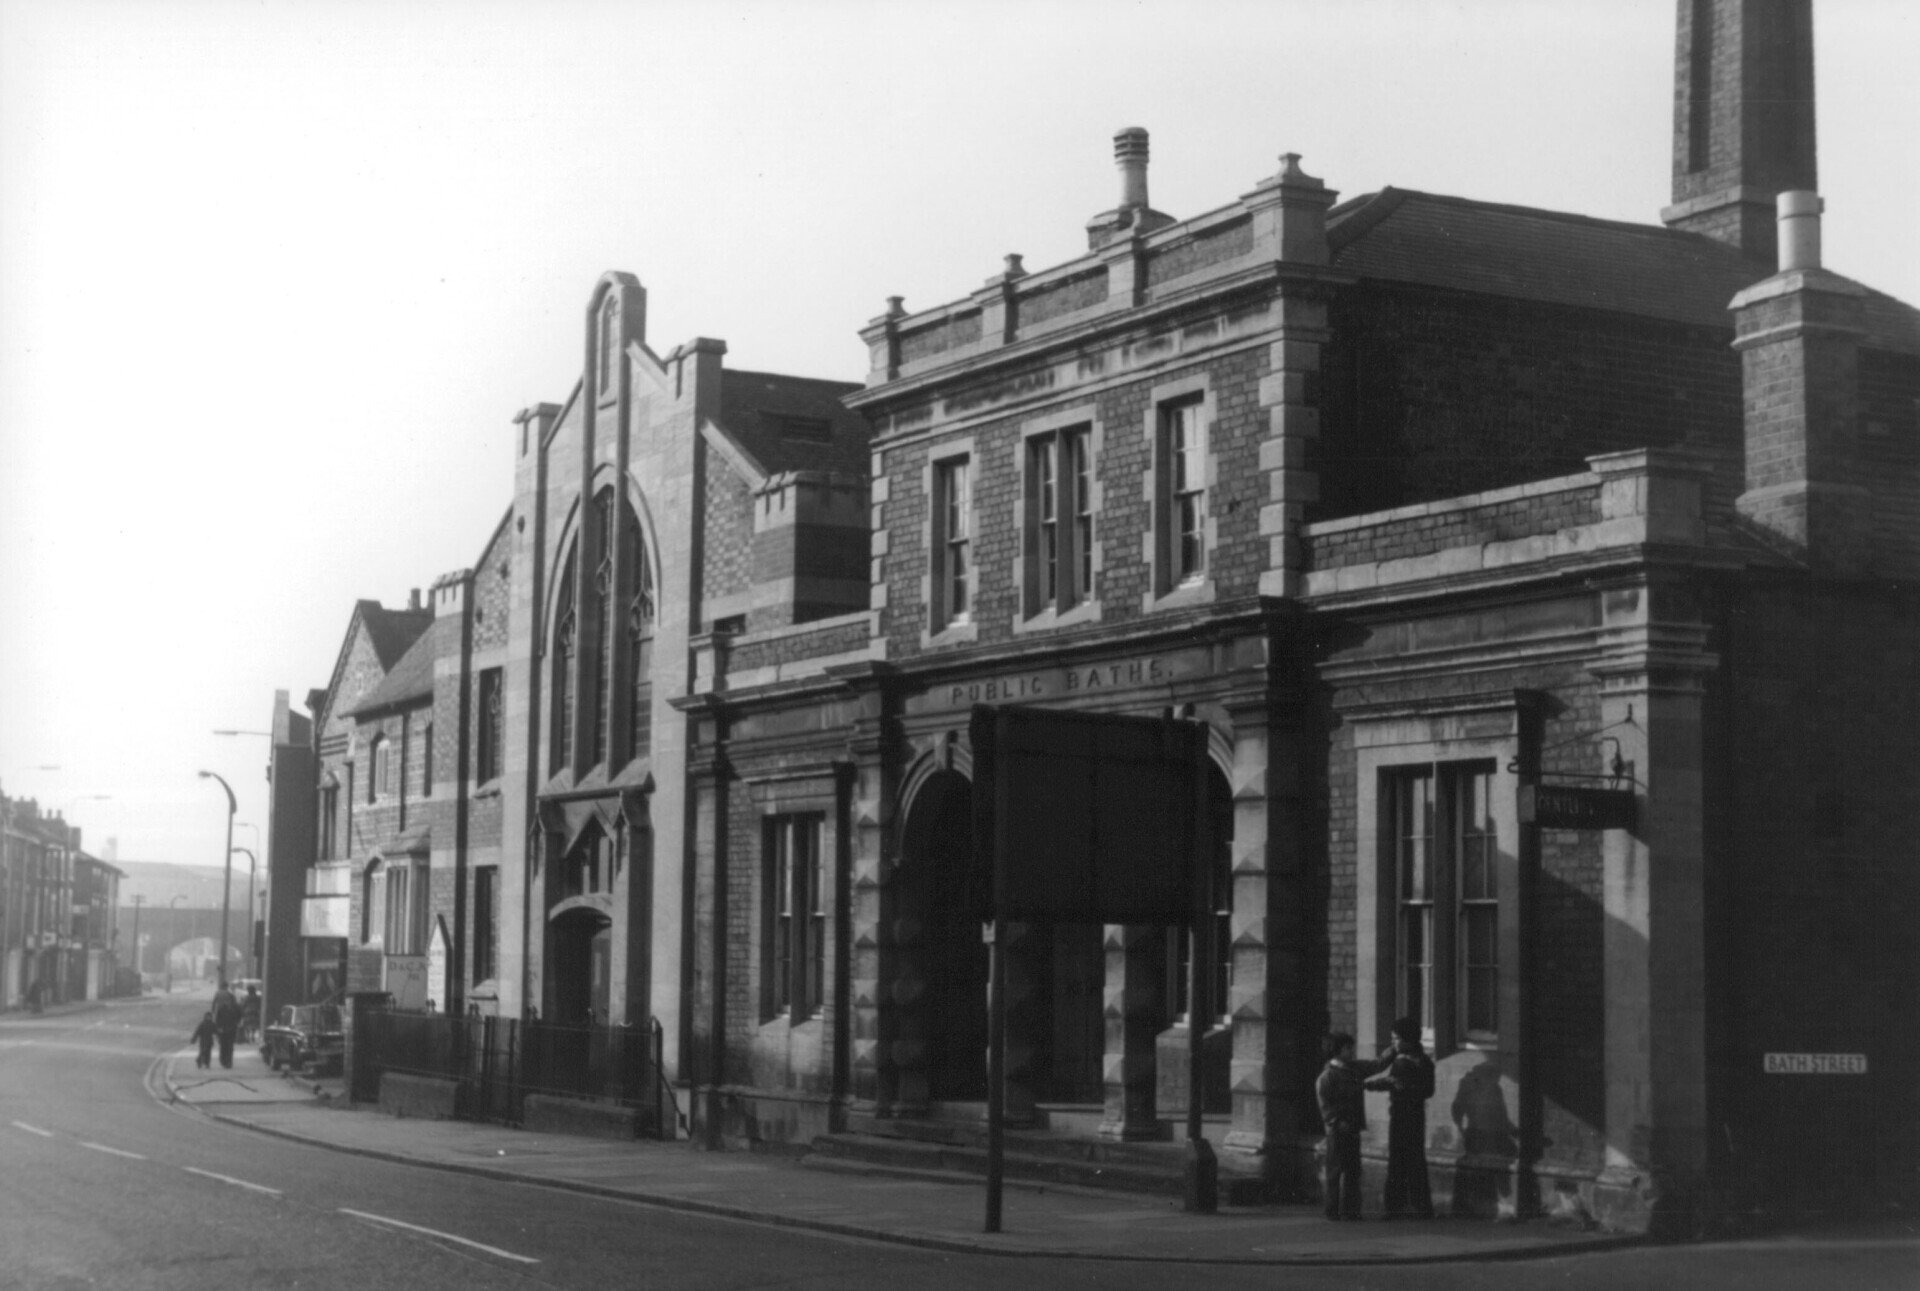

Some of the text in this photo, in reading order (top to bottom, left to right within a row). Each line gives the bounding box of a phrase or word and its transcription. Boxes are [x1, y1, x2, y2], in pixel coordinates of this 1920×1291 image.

[951, 676, 1043, 705] PUBLIC
[1768, 1055, 1863, 1071] BATH STREET
